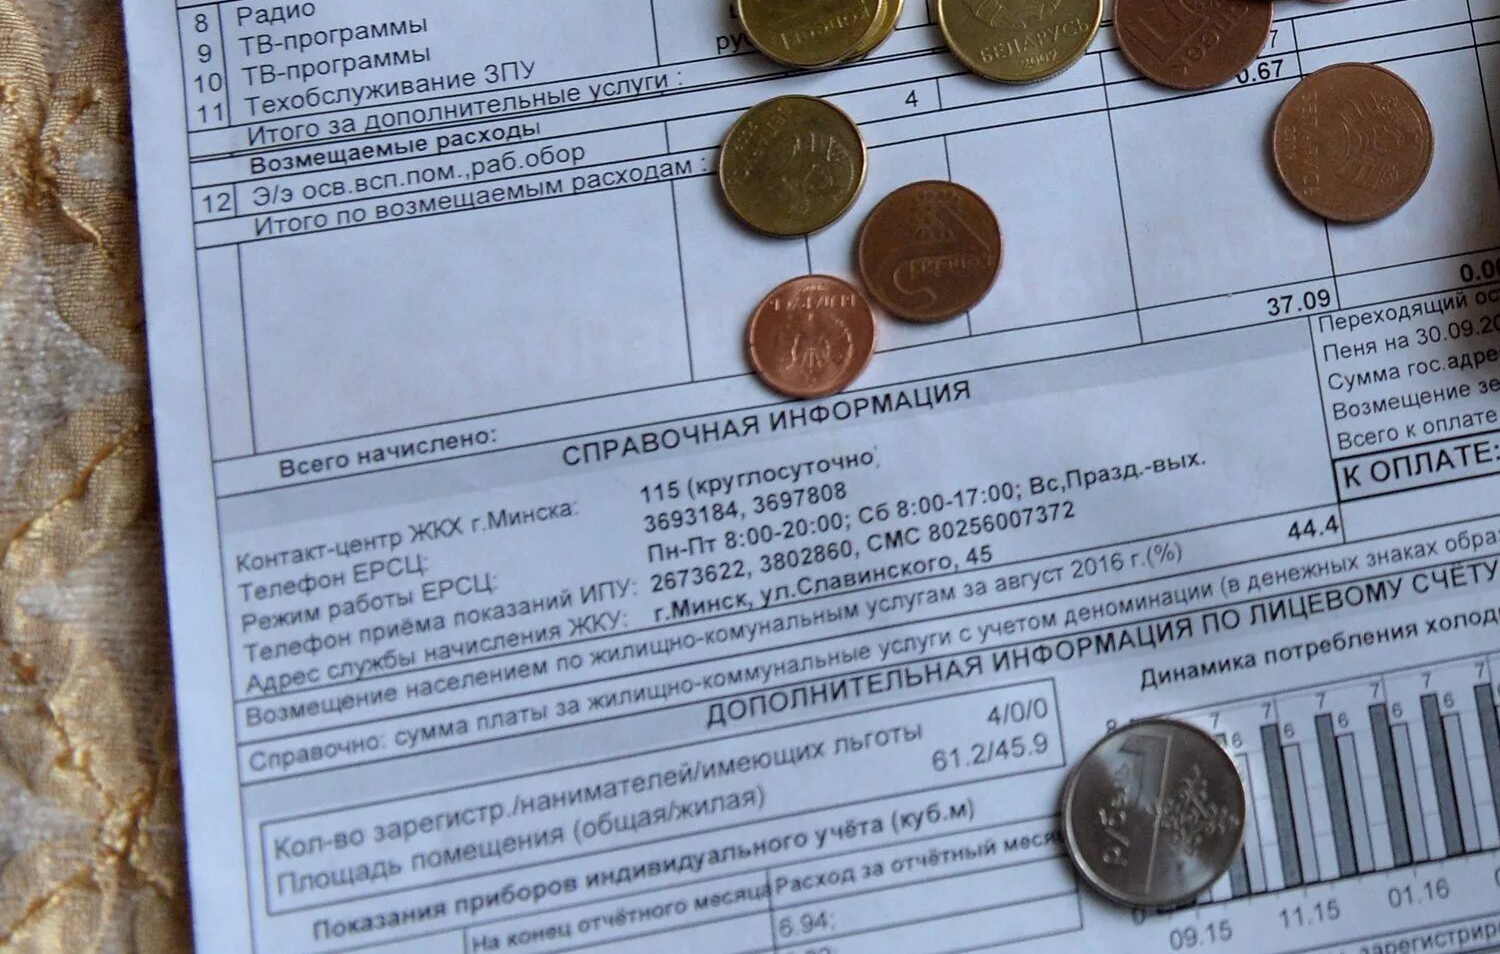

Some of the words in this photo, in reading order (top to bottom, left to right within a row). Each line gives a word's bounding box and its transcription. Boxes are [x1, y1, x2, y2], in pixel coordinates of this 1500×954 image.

[237, 0, 316, 27] Радио
[239, 17, 427, 57] ТВ-программы
[196, 103, 224, 124] 11
[245, 72, 475, 117] Техобслуживание
[248, 122, 319, 147] Итого
[365, 87, 580, 133] дополнительные
[250, 137, 427, 175] Возмещаемые
[436, 120, 540, 154] расходы
[202, 194, 231, 213] 12
[376, 181, 563, 220] возмещаемым
[572, 158, 691, 195] расходам
[1266, 290, 1331, 316] 37.09
[1319, 290, 1467, 333] Переходящий
[1332, 383, 1470, 420] Возмещение
[1423, 408, 1498, 435] оплате
[562, 416, 760, 467] СПРАВОЧНАЯ
[770, 380, 970, 431] ИНФОРМАЦИЯ
[279, 454, 349, 478] Всего
[357, 430, 497, 464] начислено:
[1370, 442, 1500, 483] ОПЛАТЕ:
[644, 505, 745, 532] 3693184,
[753, 483, 847, 513] 3697808
[648, 537, 716, 563] Пн-Пт
[724, 514, 851, 548] 8:00-20:00;
[897, 482, 1022, 518] 8:00-17:00;
[1288, 516, 1339, 539] 44.4
[236, 530, 401, 572] Контакт-центр
[411, 517, 461, 542] ЖКХ
[760, 541, 859, 573] 3802860,
[929, 501, 1075, 541] 80256007372
[239, 571, 345, 603] Телефон
[760, 556, 959, 608] ул.Славинского,
[979, 614, 1056, 646] учетом
[1064, 582, 1213, 627] деноминации
[1248, 556, 1359, 593] денежных
[329, 593, 413, 618] работы
[454, 589, 571, 628] показаний
[246, 686, 397, 727] Возмещение
[868, 584, 955, 620] услугам
[996, 567, 1062, 593] август
[1072, 552, 1123, 578] 2016
[425, 626, 560, 661] начисления
[707, 662, 982, 730] ДОПОЛНИТЕЛЬНАЯ
[993, 617, 1192, 673] ИНФОРМАЦИЯ
[1250, 578, 1403, 625] ЛИЦЕВОМУ
[1140, 655, 1256, 692] Динамика
[1265, 622, 1418, 669] потребления
[395, 718, 469, 746] сумма
[834, 723, 922, 751] льготы
[931, 733, 1048, 772] 61.2/45.9
[411, 826, 564, 873] помещения
[1388, 880, 1449, 909] 01.16
[1170, 921, 1232, 951] 09.15
